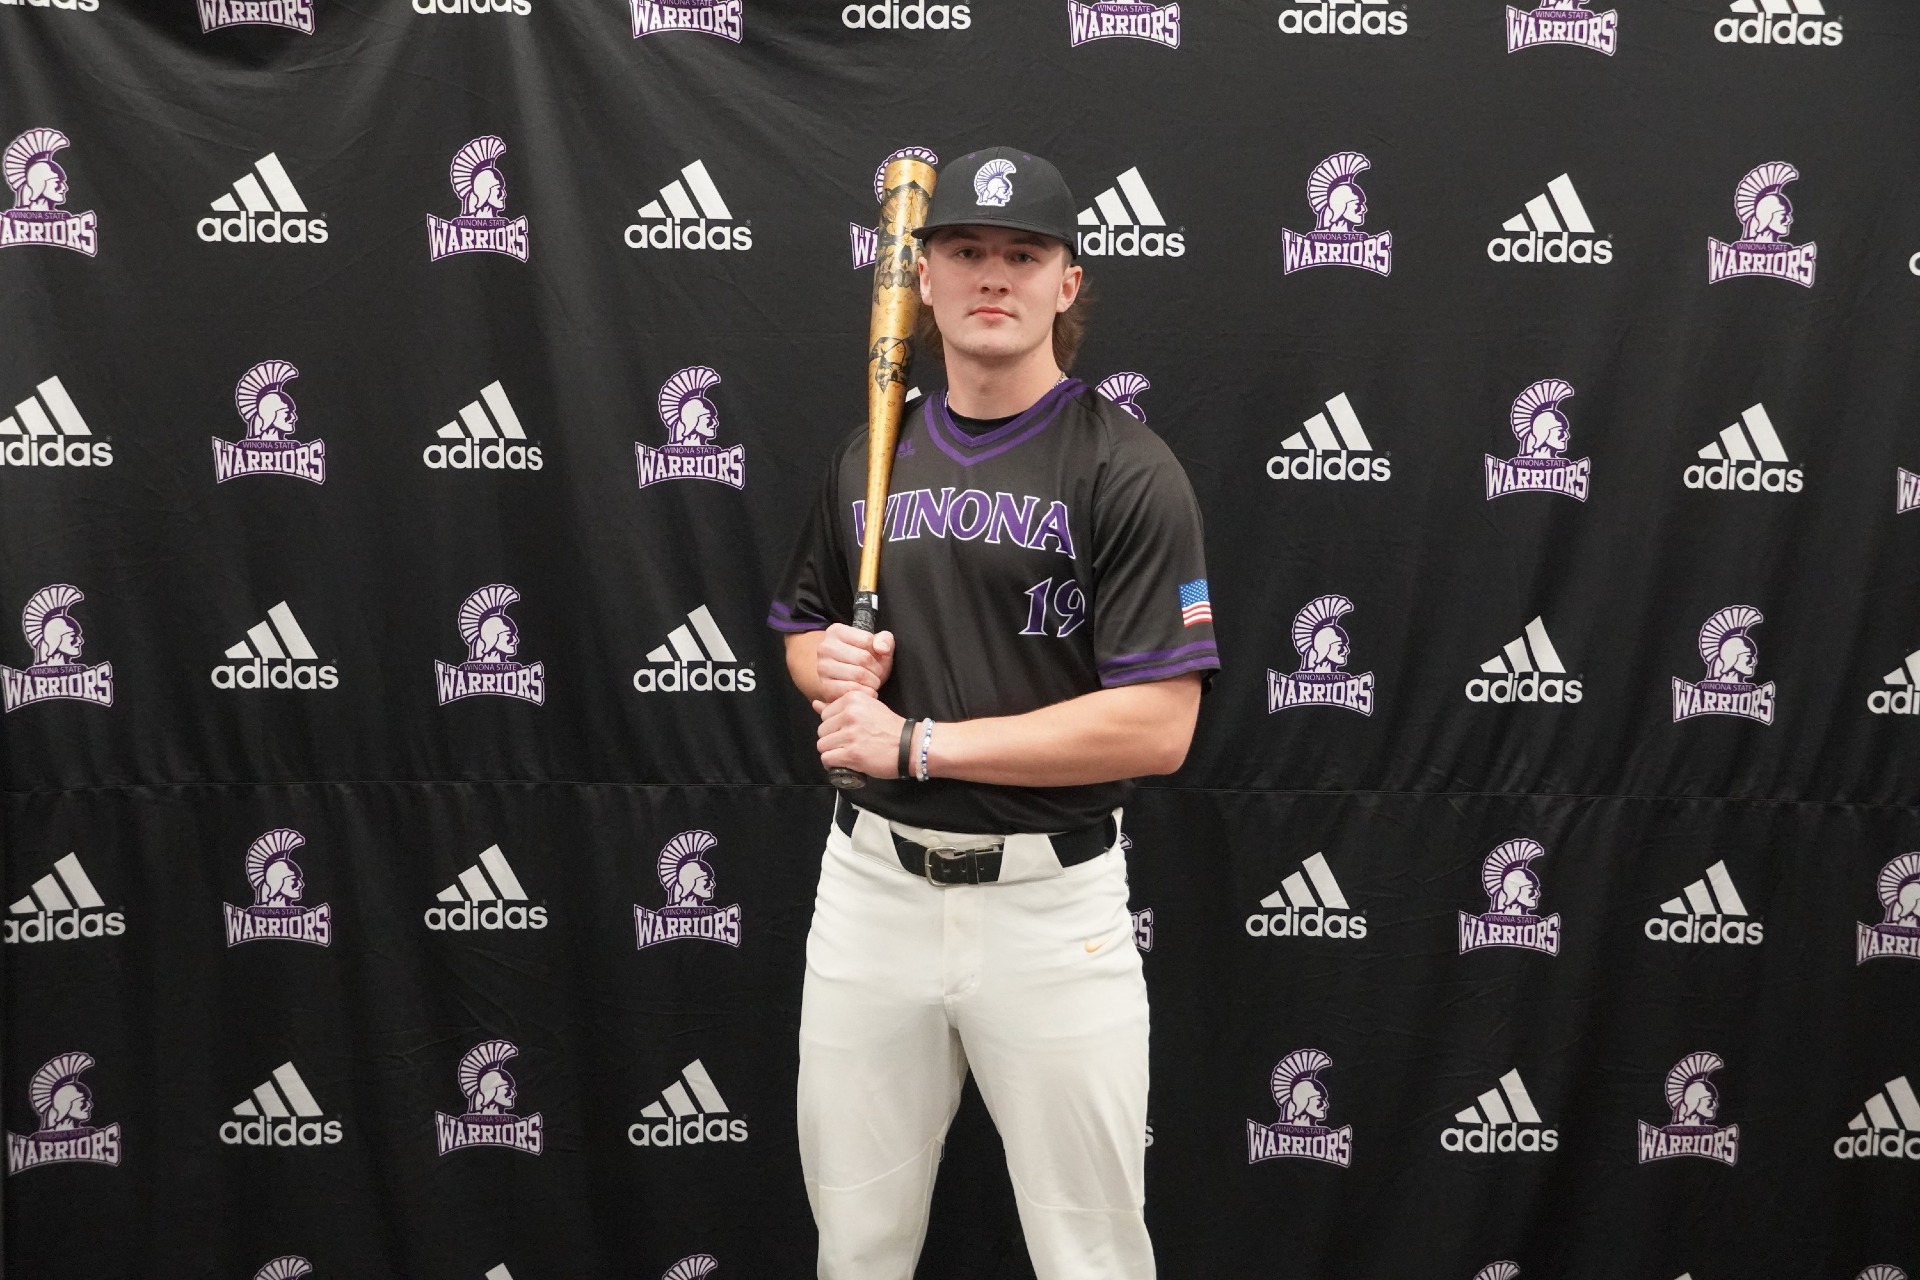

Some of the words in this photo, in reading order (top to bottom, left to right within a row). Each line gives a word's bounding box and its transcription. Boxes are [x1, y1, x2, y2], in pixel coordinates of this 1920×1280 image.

[202, 0, 312, 32] WARRIORS
[632, 0, 740, 40] WARRIORS
[842, 0, 971, 29] adidas
[1070, 2, 1177, 46] WARRIORS
[1278, 3, 1408, 35] adidas
[1509, 9, 1614, 53] WARRIORS
[1536, 11, 1566, 19] WINONA
[1567, 11, 1588, 19] STATE
[1714, 12, 1843, 46] adidas
[0, 213, 94, 255] ARRIORS
[197, 211, 328, 243] adidas
[429, 216, 525, 259] WARRIORS
[457, 219, 488, 227] WINONA
[489, 219, 506, 227] STATE
[624, 218, 752, 250] adidas
[1077, 225, 1185, 257] didas
[1284, 231, 1389, 274] WARRIORS
[1487, 231, 1613, 264] adidas
[1710, 240, 1813, 285] WARRIORS
[0, 434, 113, 466] didas
[214, 438, 322, 482] WARRIORS
[275, 441, 295, 449] STATE
[423, 438, 543, 470] adidas
[637, 444, 742, 487] WARRIORS
[1266, 449, 1391, 481] adidas
[1487, 456, 1587, 499] WARRIORS
[1683, 459, 1803, 493] adidas
[1017, 576, 1086, 637] 19
[3, 664, 110, 710] WARRIORS
[211, 658, 338, 689] adidas
[437, 662, 542, 703] WARRIORS
[633, 660, 756, 692] adidas
[1465, 671, 1582, 703] adidas
[1732, 684, 1751, 692] STATE
[1269, 671, 1371, 713] WARRIORS
[1674, 679, 1771, 722] WARRIORS
[225, 904, 328, 945] WARRIORS
[425, 900, 548, 931] adidas
[636, 906, 738, 947] WARRIORS
[1246, 907, 1367, 939] adidas
[1485, 915, 1516, 923] WINONA
[1645, 913, 1763, 944] adidas
[1460, 913, 1557, 952] WARRIORS
[1858, 924, 1920, 961] WARRI
[220, 1116, 342, 1146] adidas
[437, 1113, 540, 1153] WARRIORS
[628, 1113, 748, 1146] adidas
[1249, 1121, 1349, 1165] WARRIORS
[1275, 1126, 1305, 1134] WINONA
[1306, 1127, 1326, 1135] STATE
[1441, 1121, 1558, 1153] adidas
[1640, 1123, 1736, 1163] WARRIORS
[8, 1125, 119, 1172] WARRIORS
